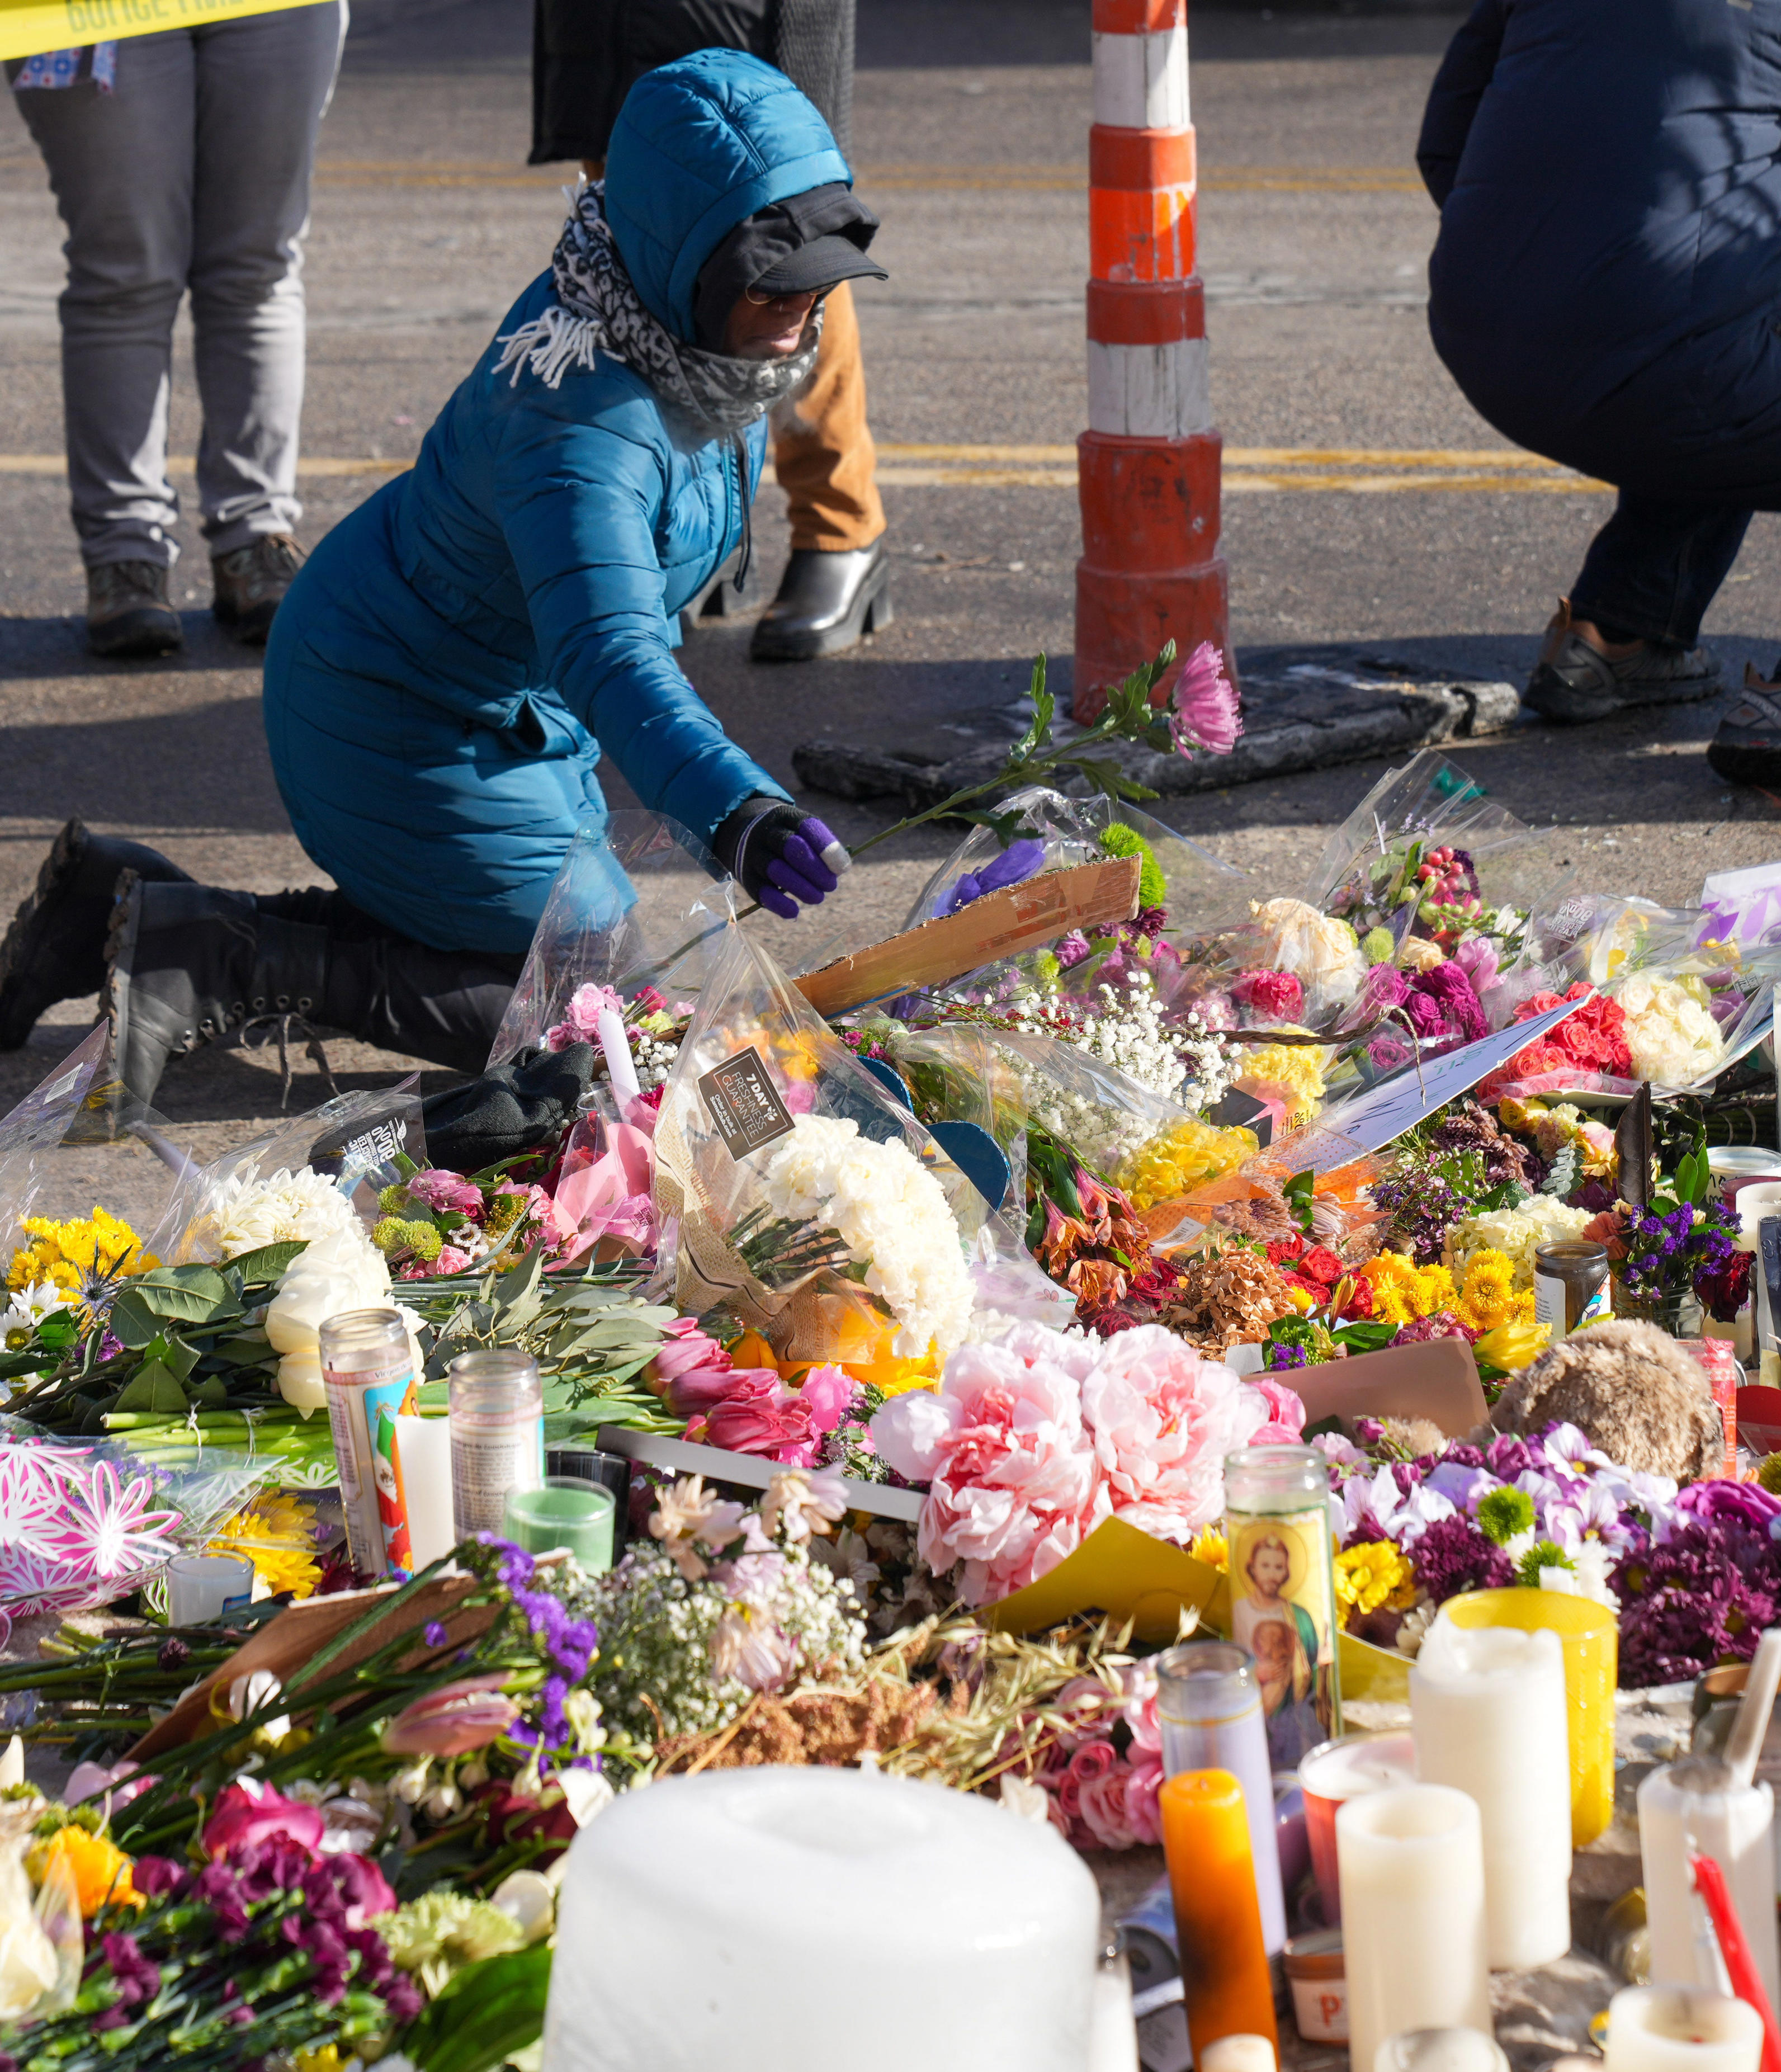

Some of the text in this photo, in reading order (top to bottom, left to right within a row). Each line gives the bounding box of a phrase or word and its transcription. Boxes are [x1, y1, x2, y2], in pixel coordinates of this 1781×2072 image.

[722, 1075, 759, 1138] GUARANTEE
[732, 1072, 767, 1130] FRESHNESS
[747, 1073, 769, 1106] 7 DAY
[710, 1096, 733, 1138] SamsClub.com
[715, 1094, 724, 1111] Order
[725, 1116, 734, 1129] bulk
